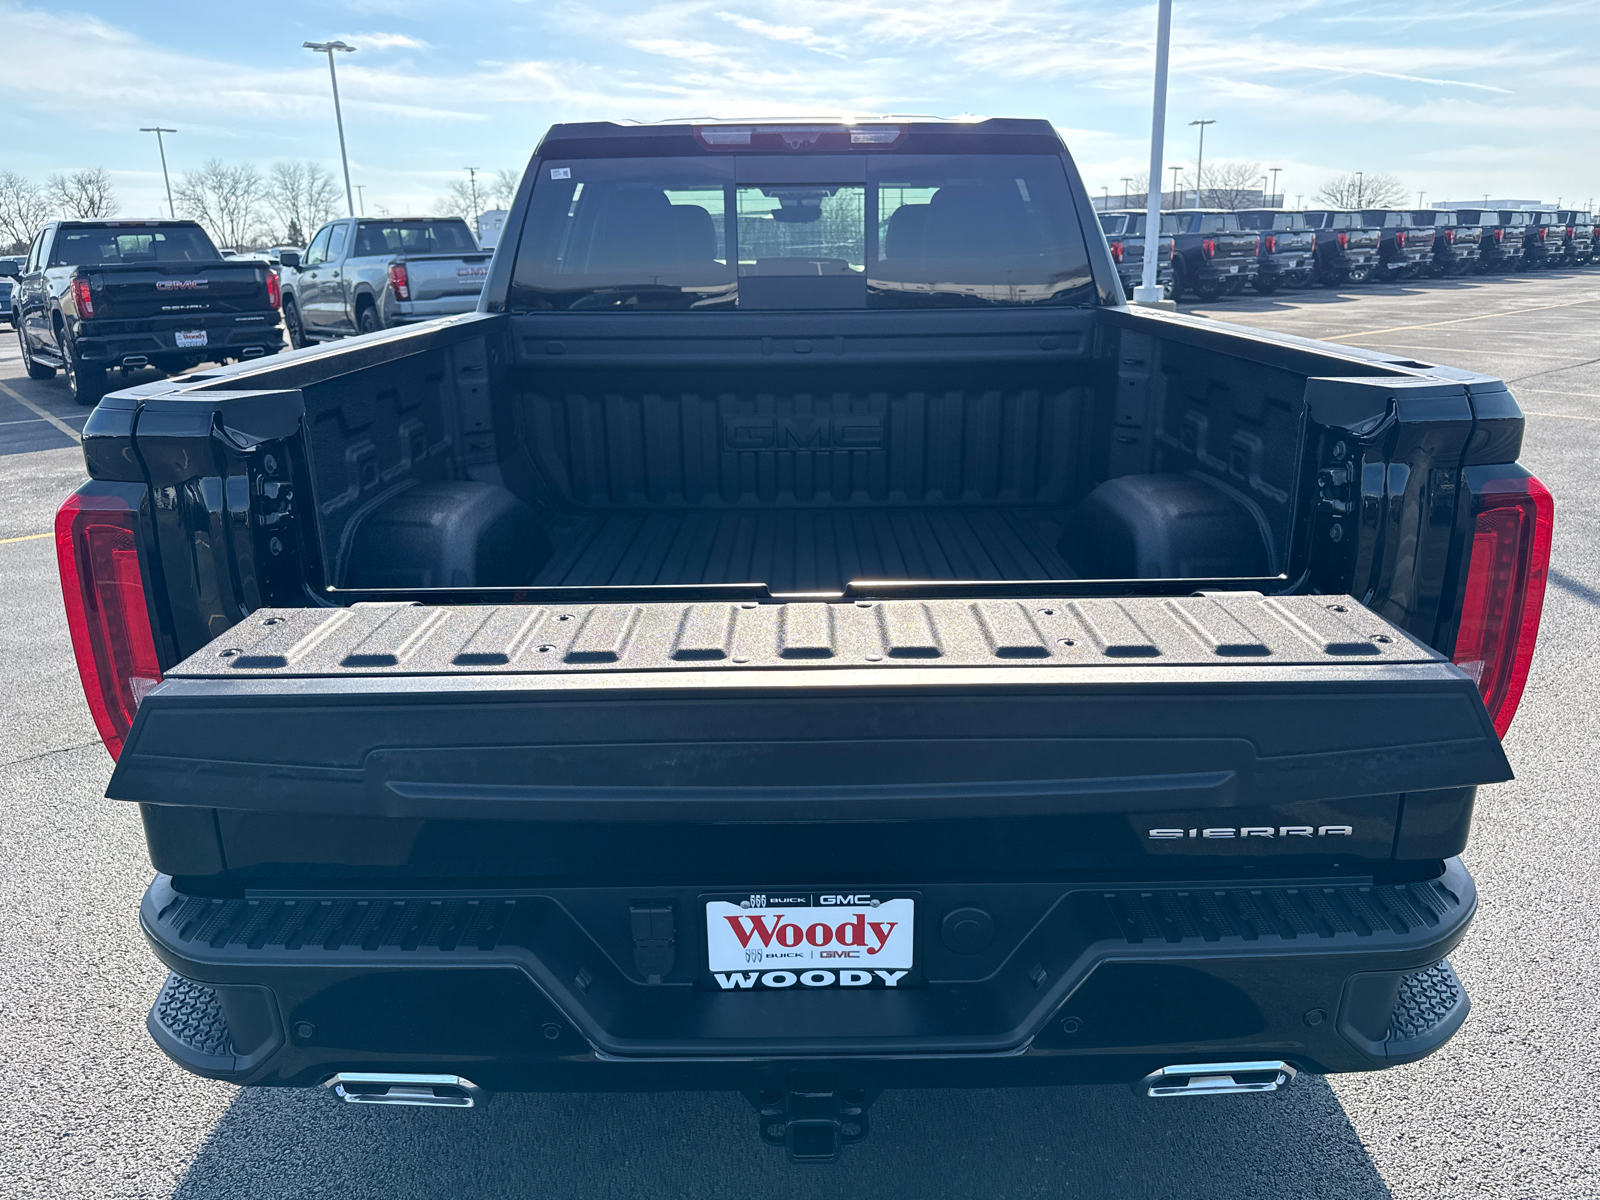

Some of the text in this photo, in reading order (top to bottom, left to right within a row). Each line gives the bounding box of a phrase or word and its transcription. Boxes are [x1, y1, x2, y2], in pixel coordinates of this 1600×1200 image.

[156, 279, 209, 291] GMC
[726, 417, 882, 450] GMC
[1148, 825, 1353, 840] SIERRA
[819, 894, 871, 906] GMC
[723, 913, 899, 956] Woody
[819, 950, 861, 959] GMC
[713, 970, 909, 989] WOODY
